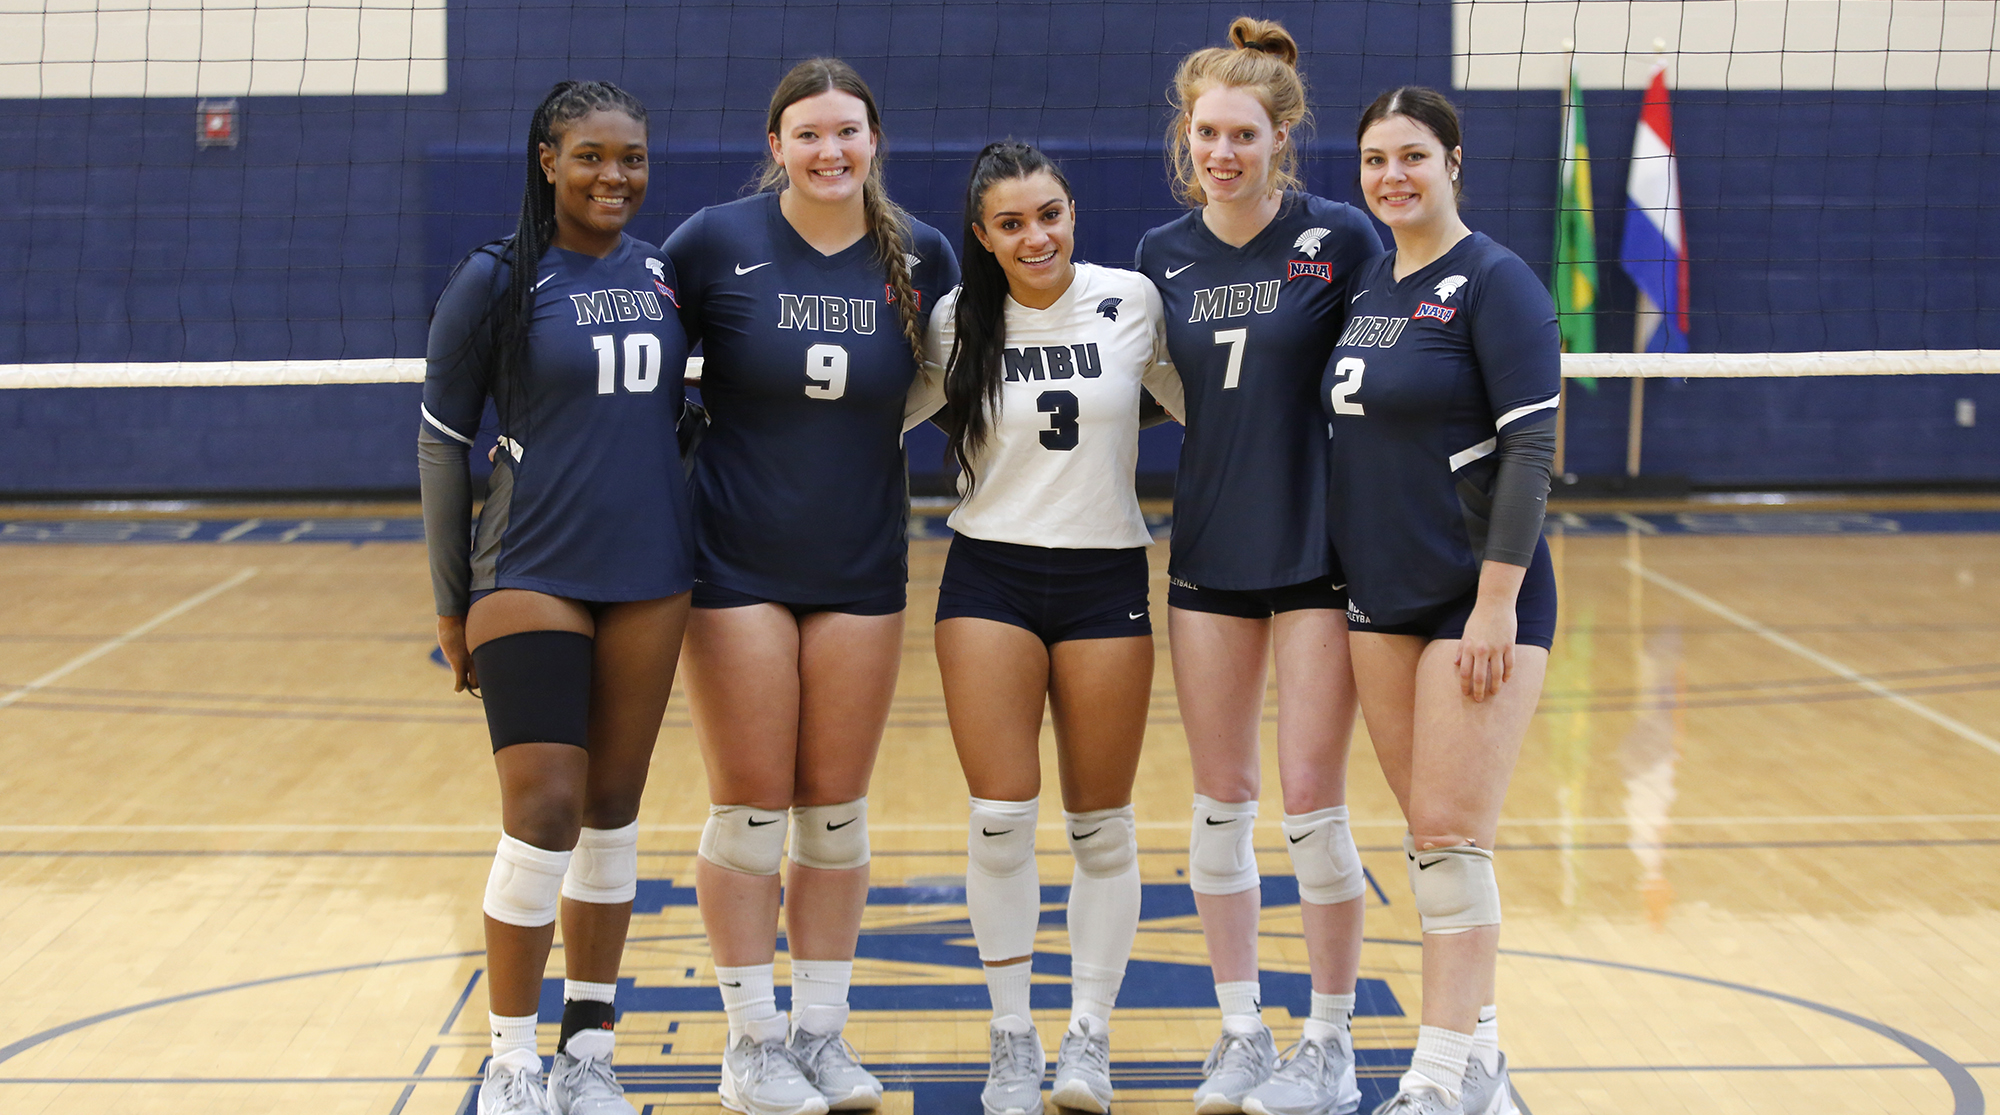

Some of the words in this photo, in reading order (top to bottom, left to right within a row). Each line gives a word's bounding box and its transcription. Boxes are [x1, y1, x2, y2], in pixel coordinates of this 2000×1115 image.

[1289, 262, 1330, 280] NAIA
[569, 288, 664, 326] MBU
[777, 293, 876, 335] MBU
[1188, 279, 1281, 323] MBU
[1415, 303, 1455, 322] NAIA
[1335, 315, 1409, 349] MBU
[591, 332, 662, 396] 10
[804, 343, 849, 401] 9
[1002, 342, 1103, 383] MBU
[1213, 327, 1248, 390] 7
[1331, 356, 1366, 416] 2
[1036, 389, 1080, 452] 3
